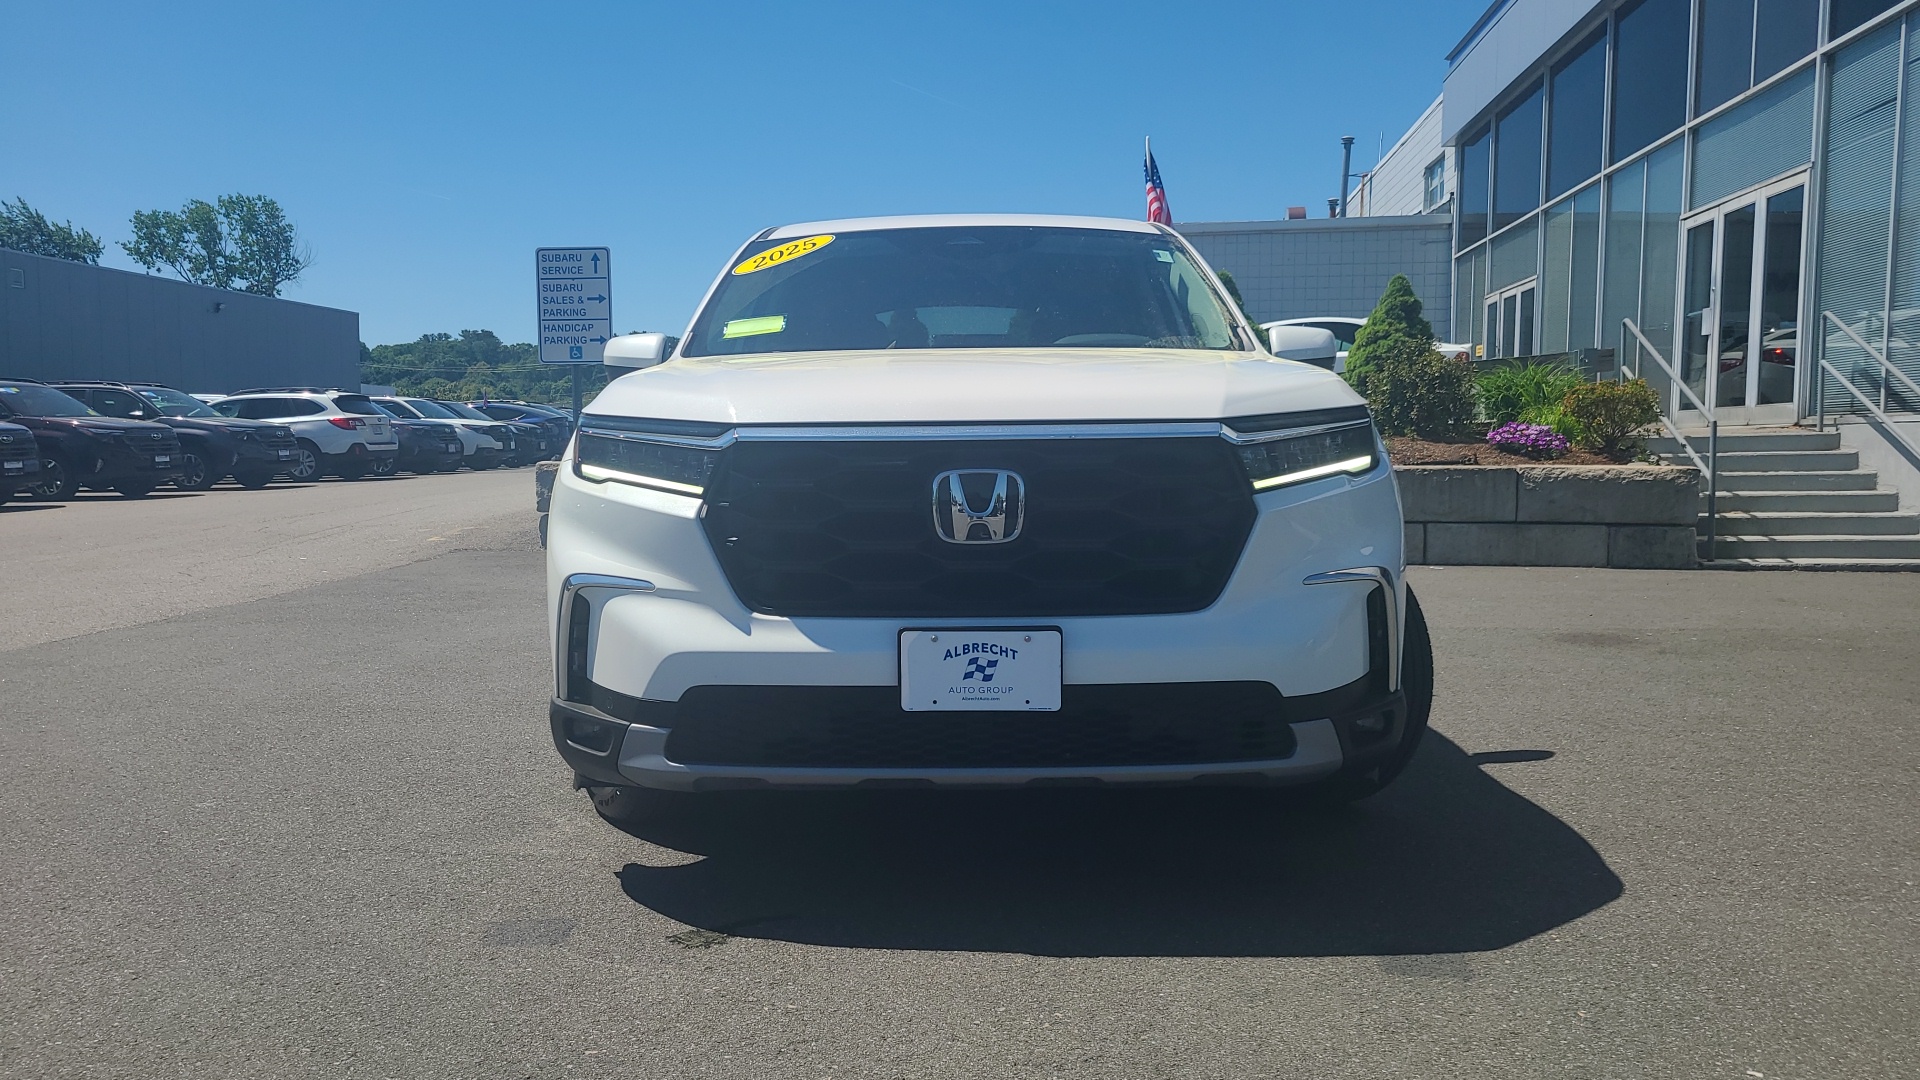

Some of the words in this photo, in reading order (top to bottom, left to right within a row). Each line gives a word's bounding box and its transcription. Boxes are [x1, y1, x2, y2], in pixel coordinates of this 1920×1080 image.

[753, 238, 817, 269] 2025
[541, 254, 582, 263] SUBARU
[541, 266, 584, 275] SERVICE
[542, 283, 583, 292] SUBARU
[542, 296, 574, 305] SALES
[577, 296, 584, 304] &
[543, 308, 587, 317] PARKING
[543, 323, 594, 333] HANDICAP
[544, 336, 587, 345] PARKING
[943, 642, 1019, 661] ALBRECHT
[948, 686, 976, 694] AUTO
[978, 686, 1014, 694] GROUP
